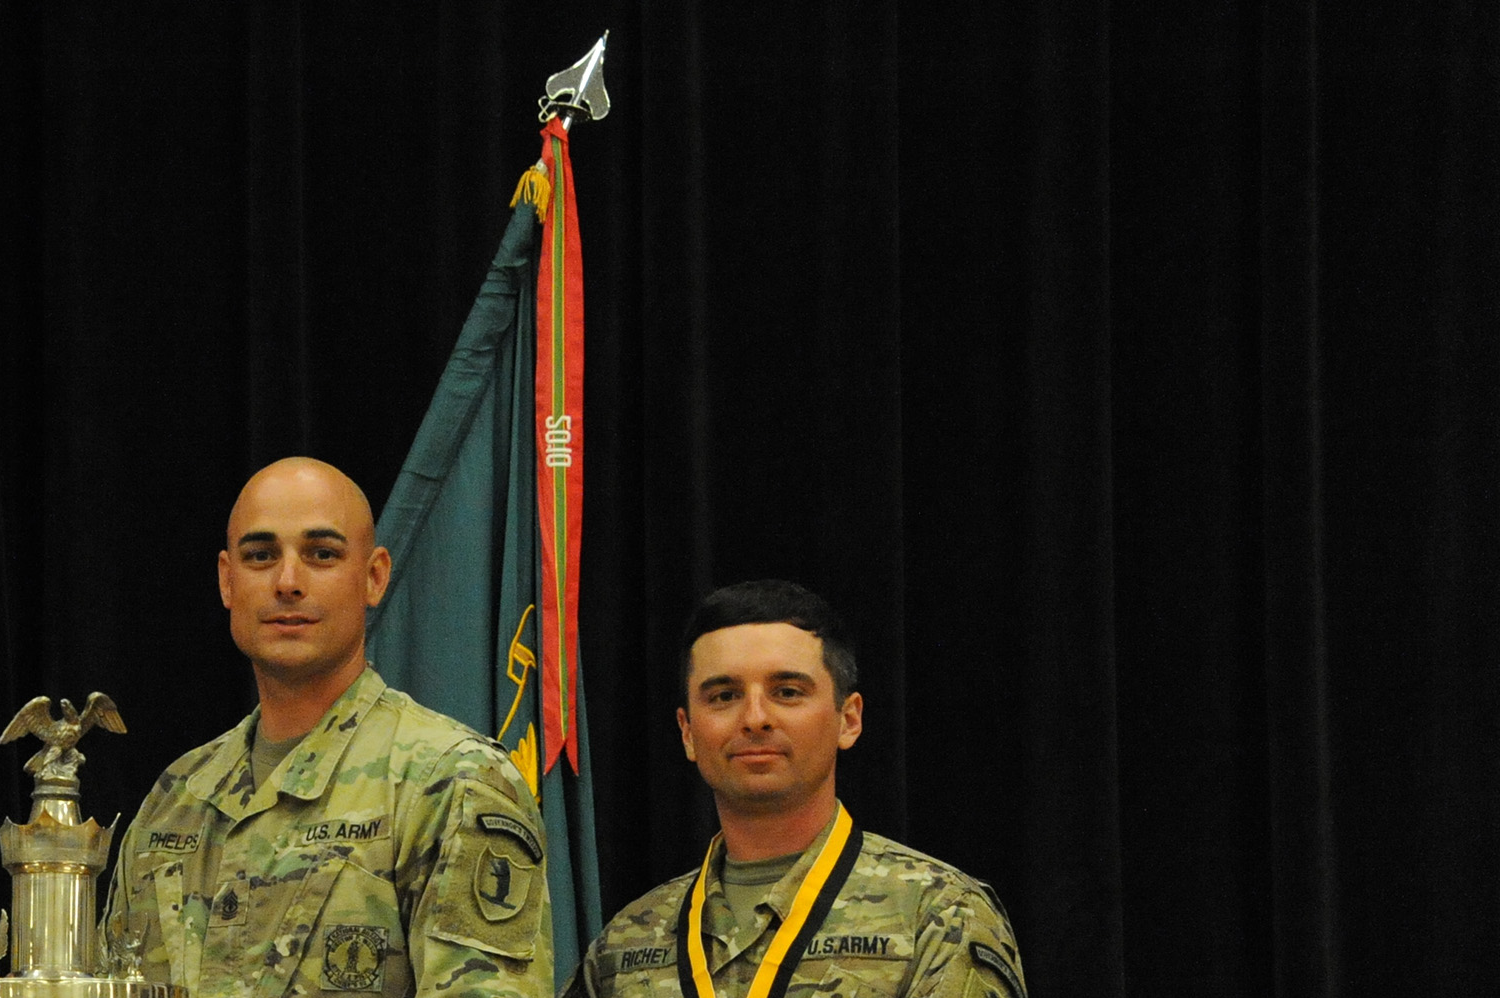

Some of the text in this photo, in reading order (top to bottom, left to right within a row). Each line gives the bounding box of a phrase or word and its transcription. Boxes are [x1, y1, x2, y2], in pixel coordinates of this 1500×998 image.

[148, 832, 199, 850] PHELPS
[306, 820, 382, 841] U.S. ARMY
[621, 947, 671, 968] RICHEY
